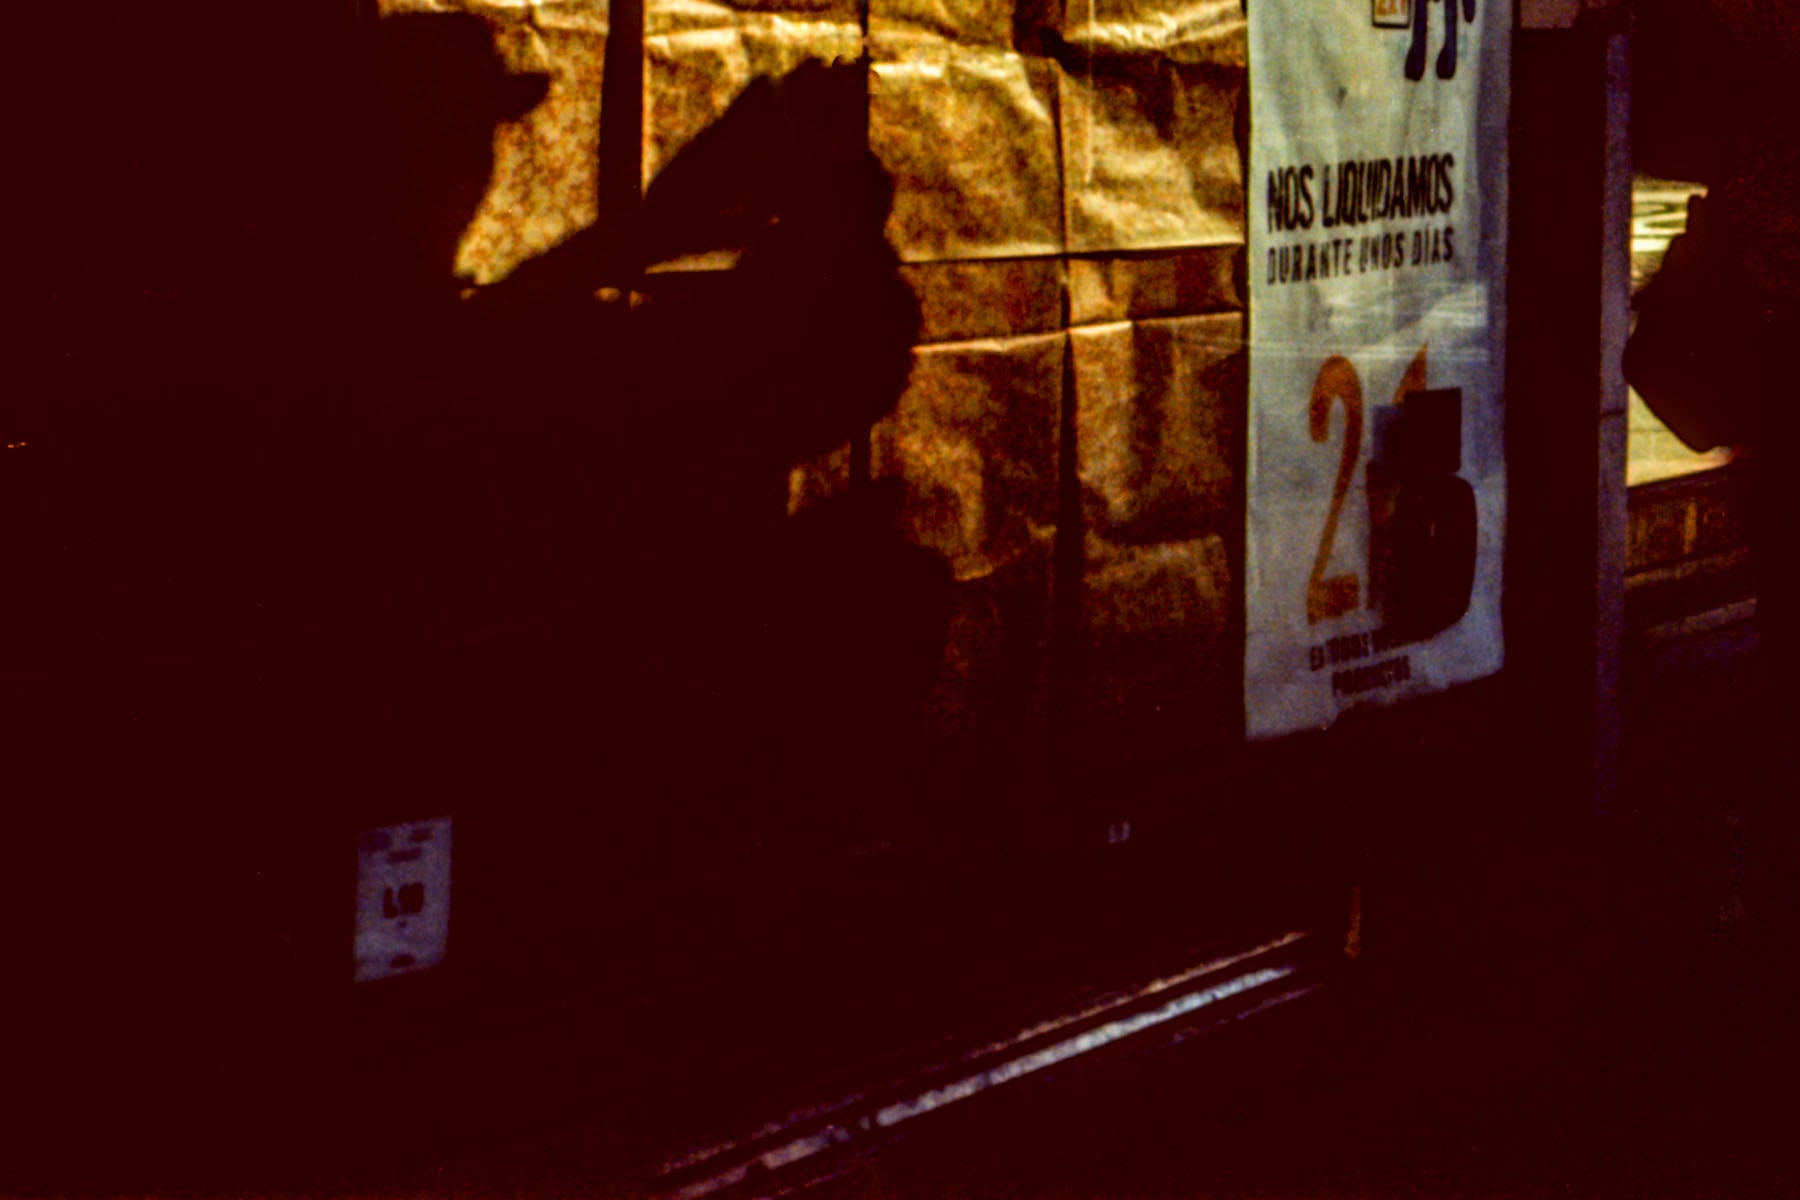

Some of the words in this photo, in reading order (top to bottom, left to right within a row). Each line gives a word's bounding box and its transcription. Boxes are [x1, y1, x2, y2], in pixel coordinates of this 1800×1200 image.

[1267, 163, 1314, 233] NOS
[1322, 153, 1454, 228] LIQUIDAMOS
[1266, 238, 1352, 286] DURANTE
[1359, 232, 1404, 272] UNOS
